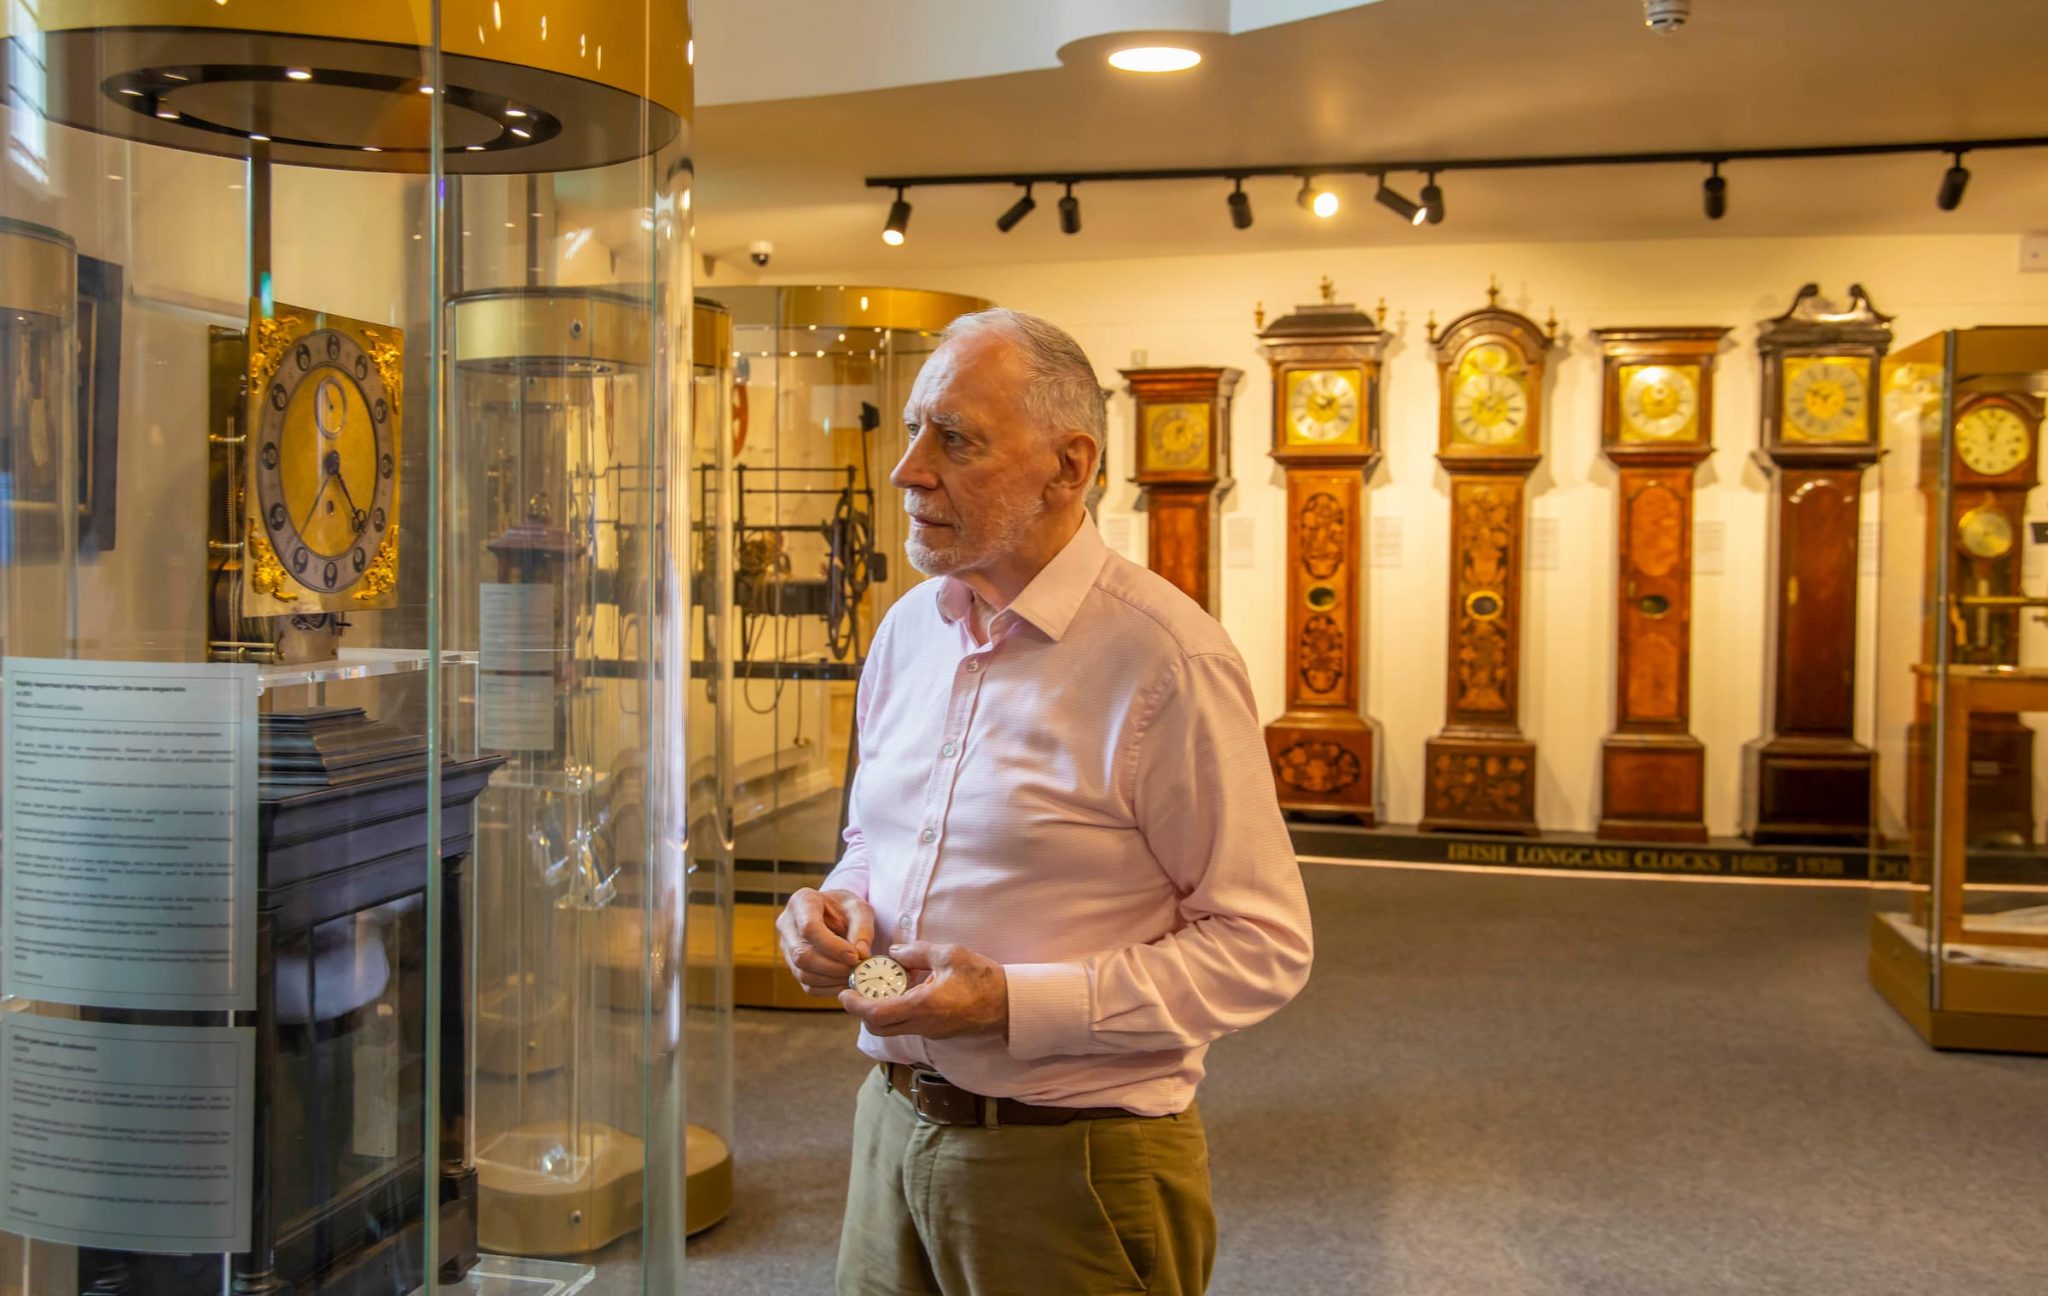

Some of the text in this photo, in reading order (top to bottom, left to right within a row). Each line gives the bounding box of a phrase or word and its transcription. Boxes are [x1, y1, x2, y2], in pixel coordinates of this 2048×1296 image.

[1448, 844, 1506, 862] IRISH
[1517, 847, 1629, 868] LONGCASE
[1634, 850, 1722, 872] CLOCKS
